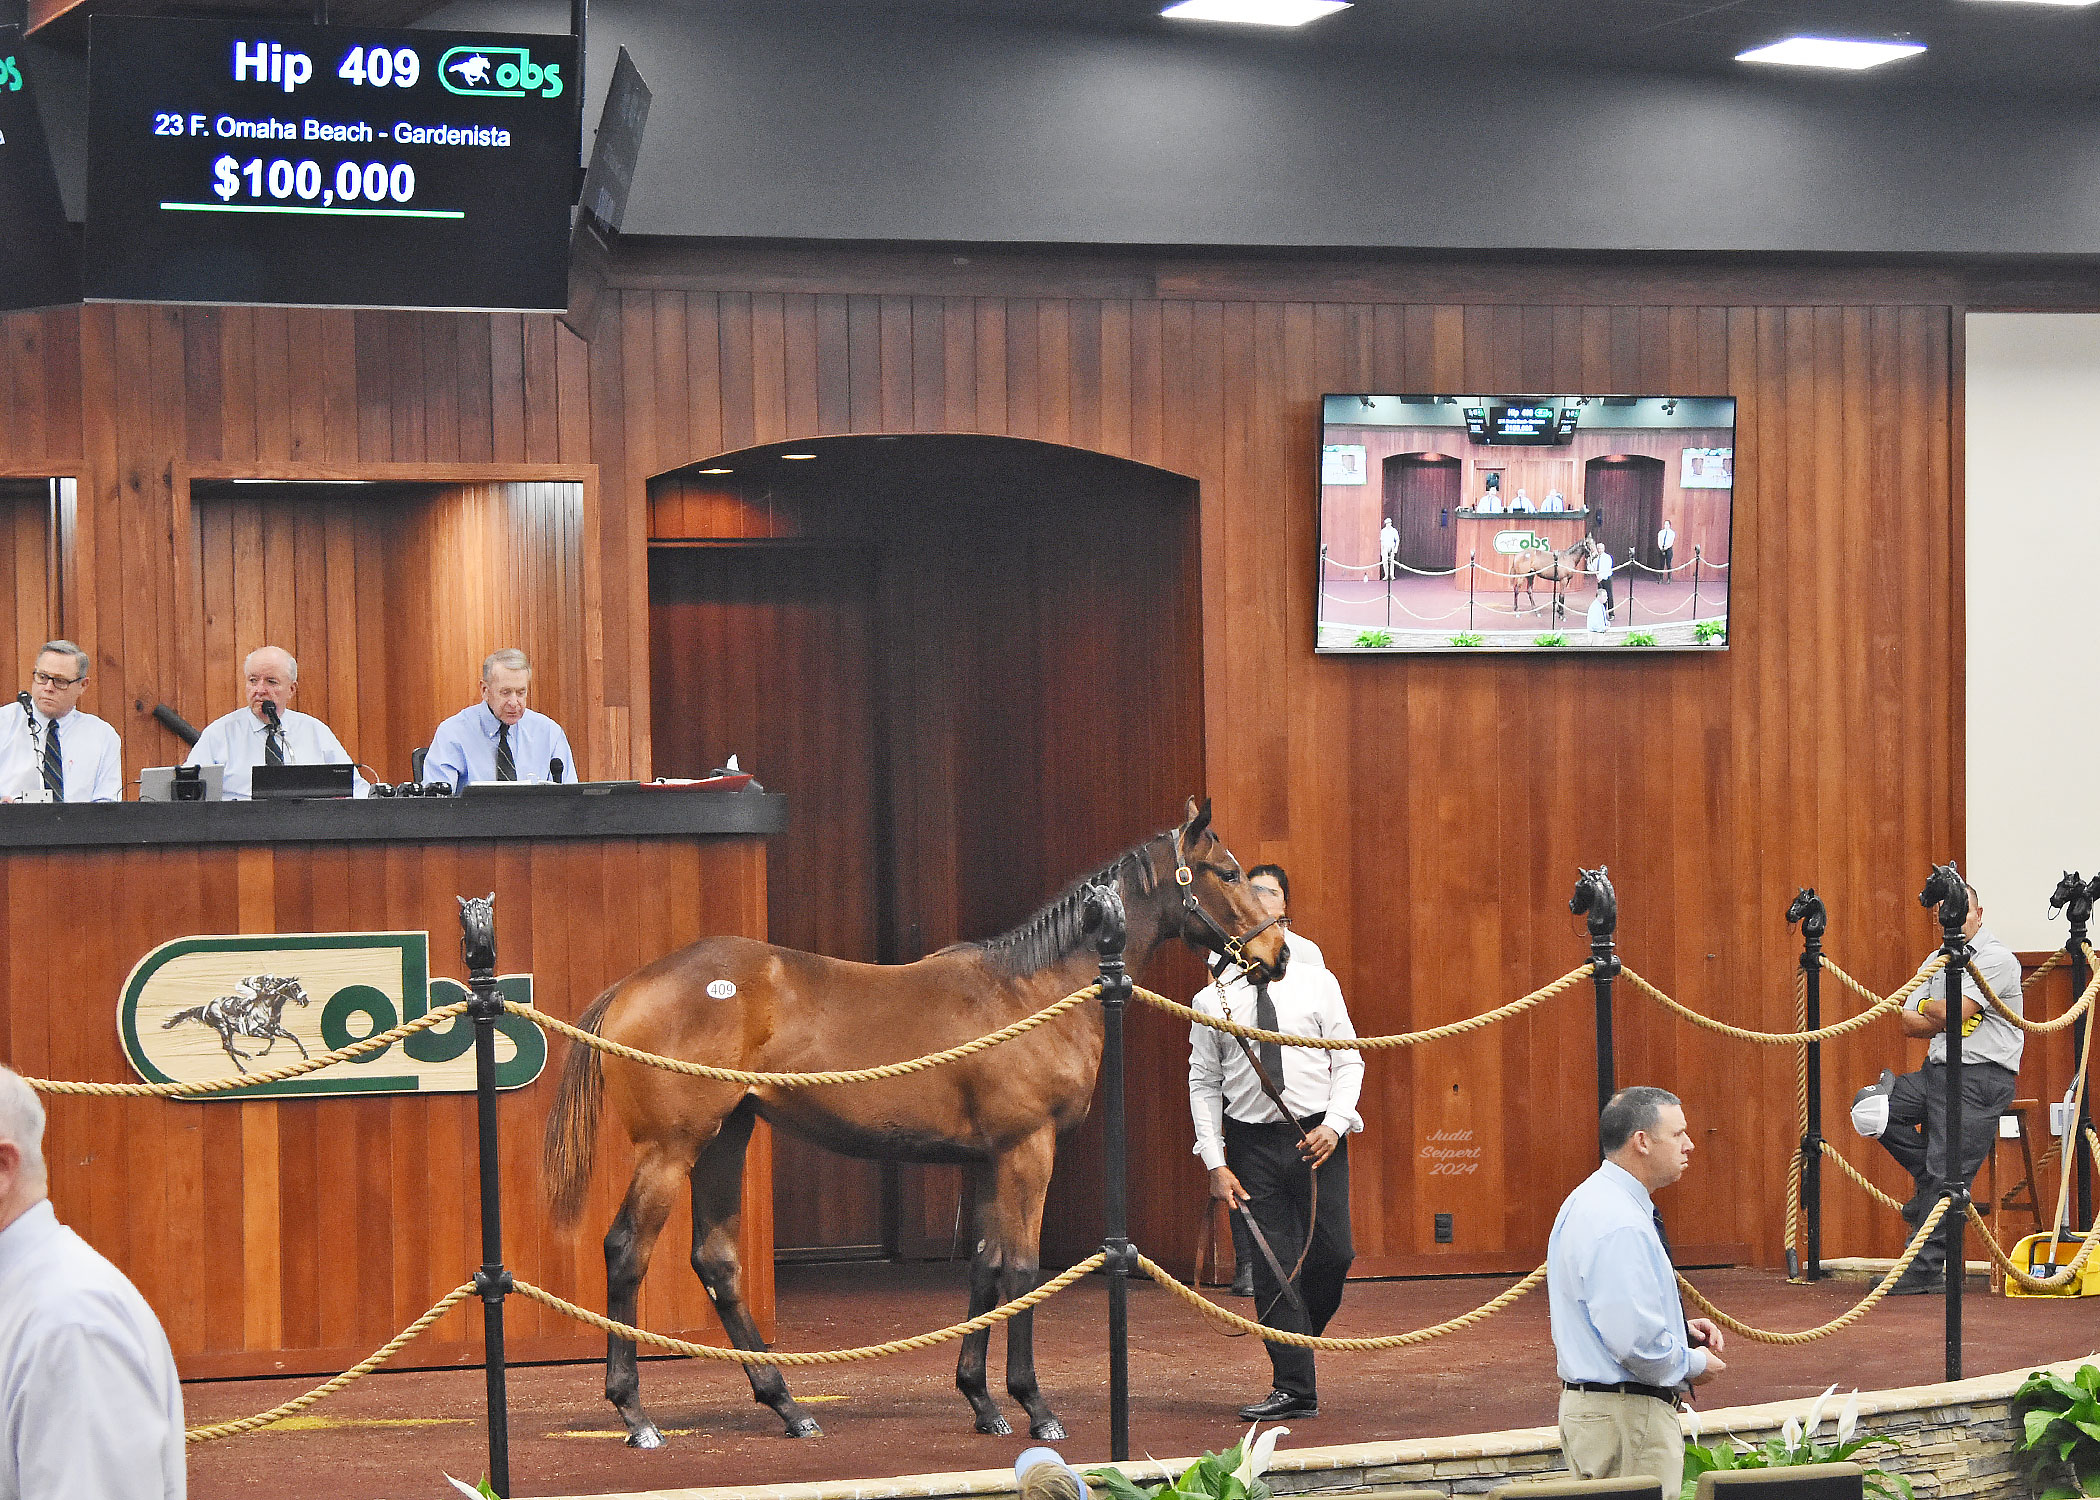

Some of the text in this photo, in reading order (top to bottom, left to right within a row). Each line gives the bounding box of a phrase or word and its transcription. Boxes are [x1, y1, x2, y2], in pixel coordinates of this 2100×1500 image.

[235, 41, 564, 98] Hip 409 obs
[155, 113, 184, 136] 23
[190, 114, 210, 137] F.
[216, 116, 297, 140] Omaha
[303, 119, 373, 143] Beach
[394, 122, 511, 147] Gardenista
[213, 154, 416, 207] $100,000
[321, 934, 547, 1087] obs
[710, 983, 733, 996] 409
